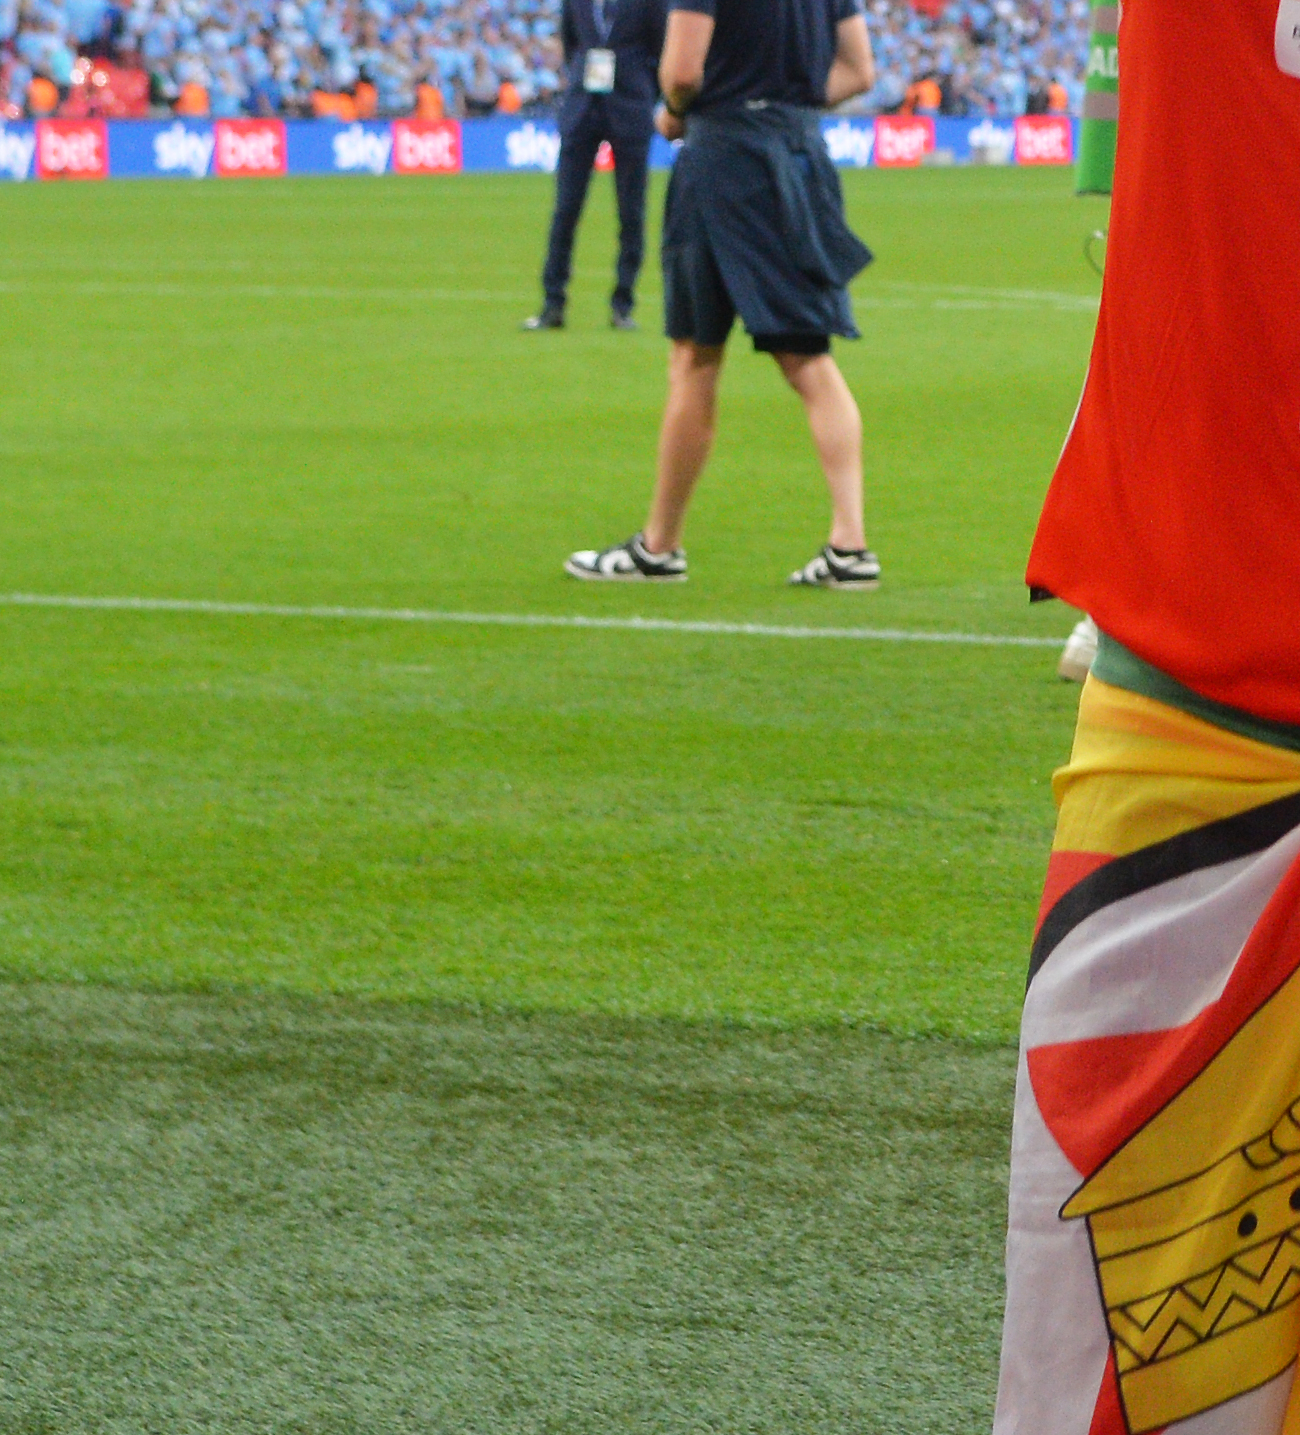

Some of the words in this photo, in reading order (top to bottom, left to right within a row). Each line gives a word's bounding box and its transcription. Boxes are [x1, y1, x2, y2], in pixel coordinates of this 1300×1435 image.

[0, 126, 36, 182] ky
[40, 125, 100, 171] bet
[153, 122, 215, 178] sky
[221, 125, 277, 170] bet
[332, 122, 393, 176] sky
[397, 127, 456, 170] bet
[506, 121, 561, 173] sky
[824, 119, 875, 168] sky
[878, 121, 930, 161] bet
[1018, 121, 1067, 161] bet
